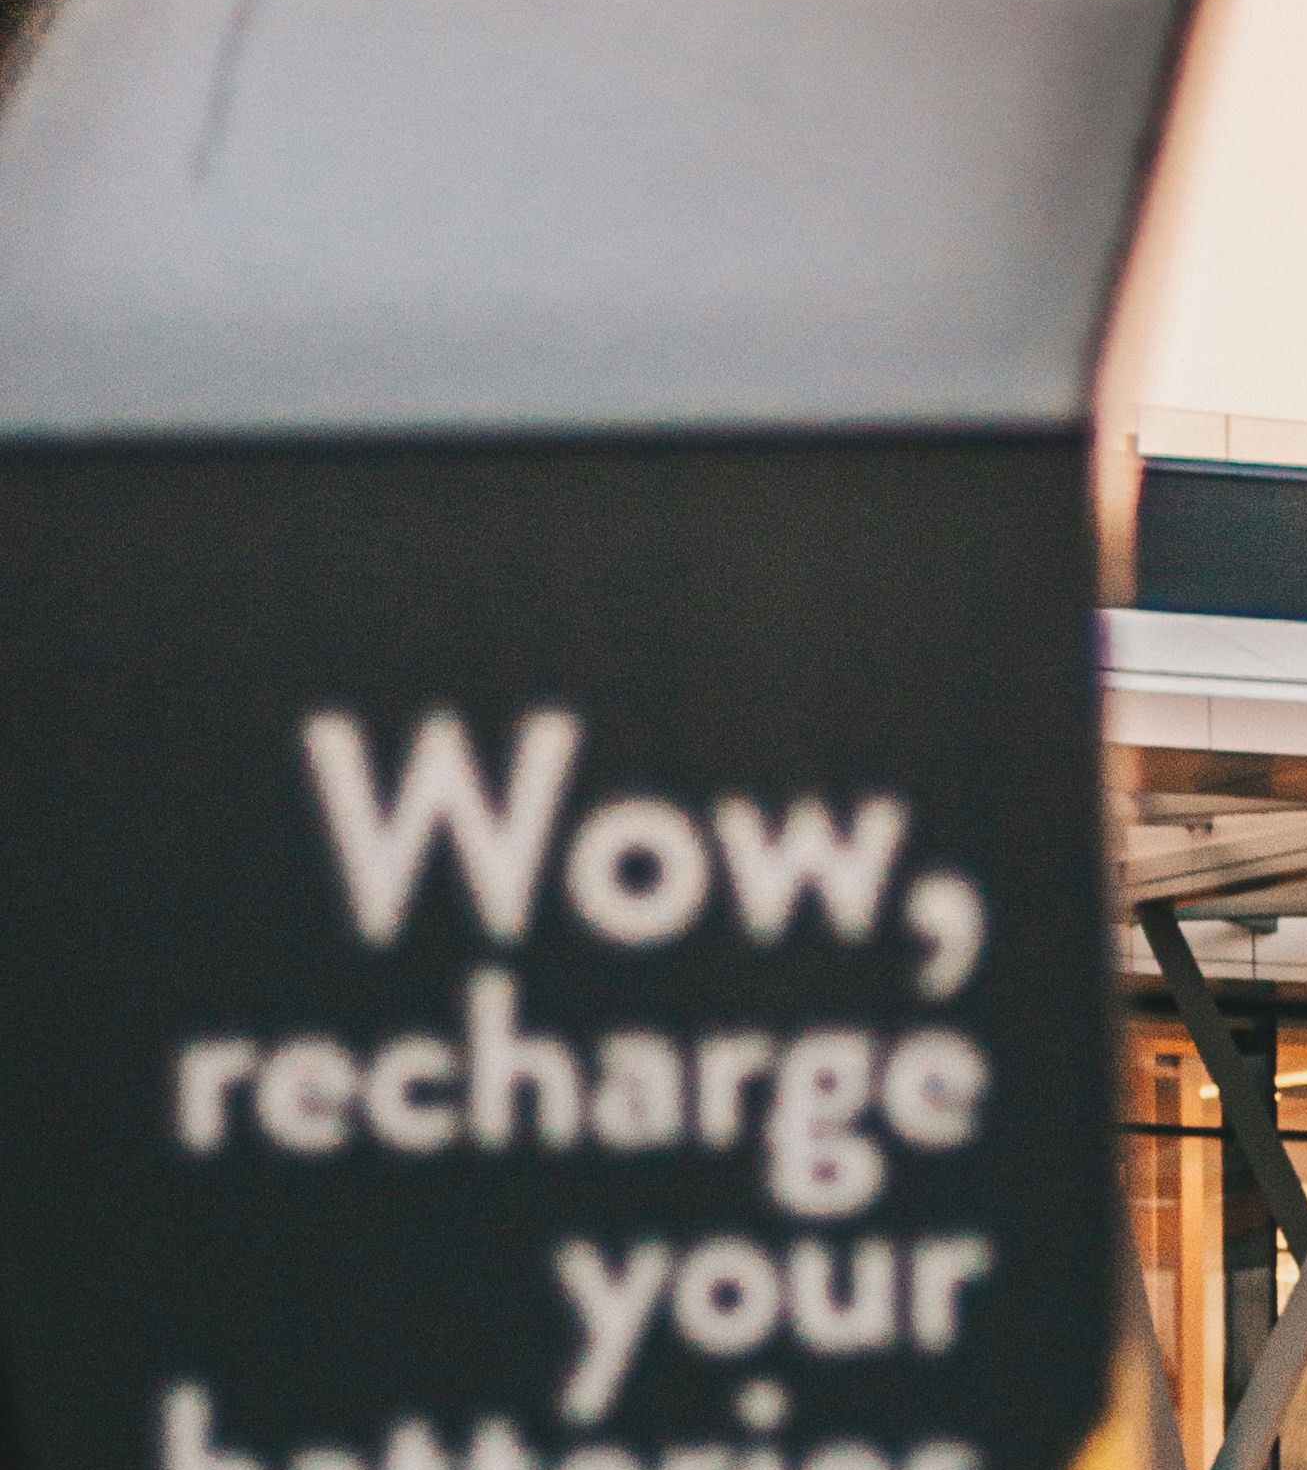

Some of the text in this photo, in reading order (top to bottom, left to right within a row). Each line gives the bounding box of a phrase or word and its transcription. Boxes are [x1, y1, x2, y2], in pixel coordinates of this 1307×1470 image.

[302, 706, 988, 1000] Wow,
[174, 969, 990, 1220] recharge
[553, 1232, 990, 1422] your
